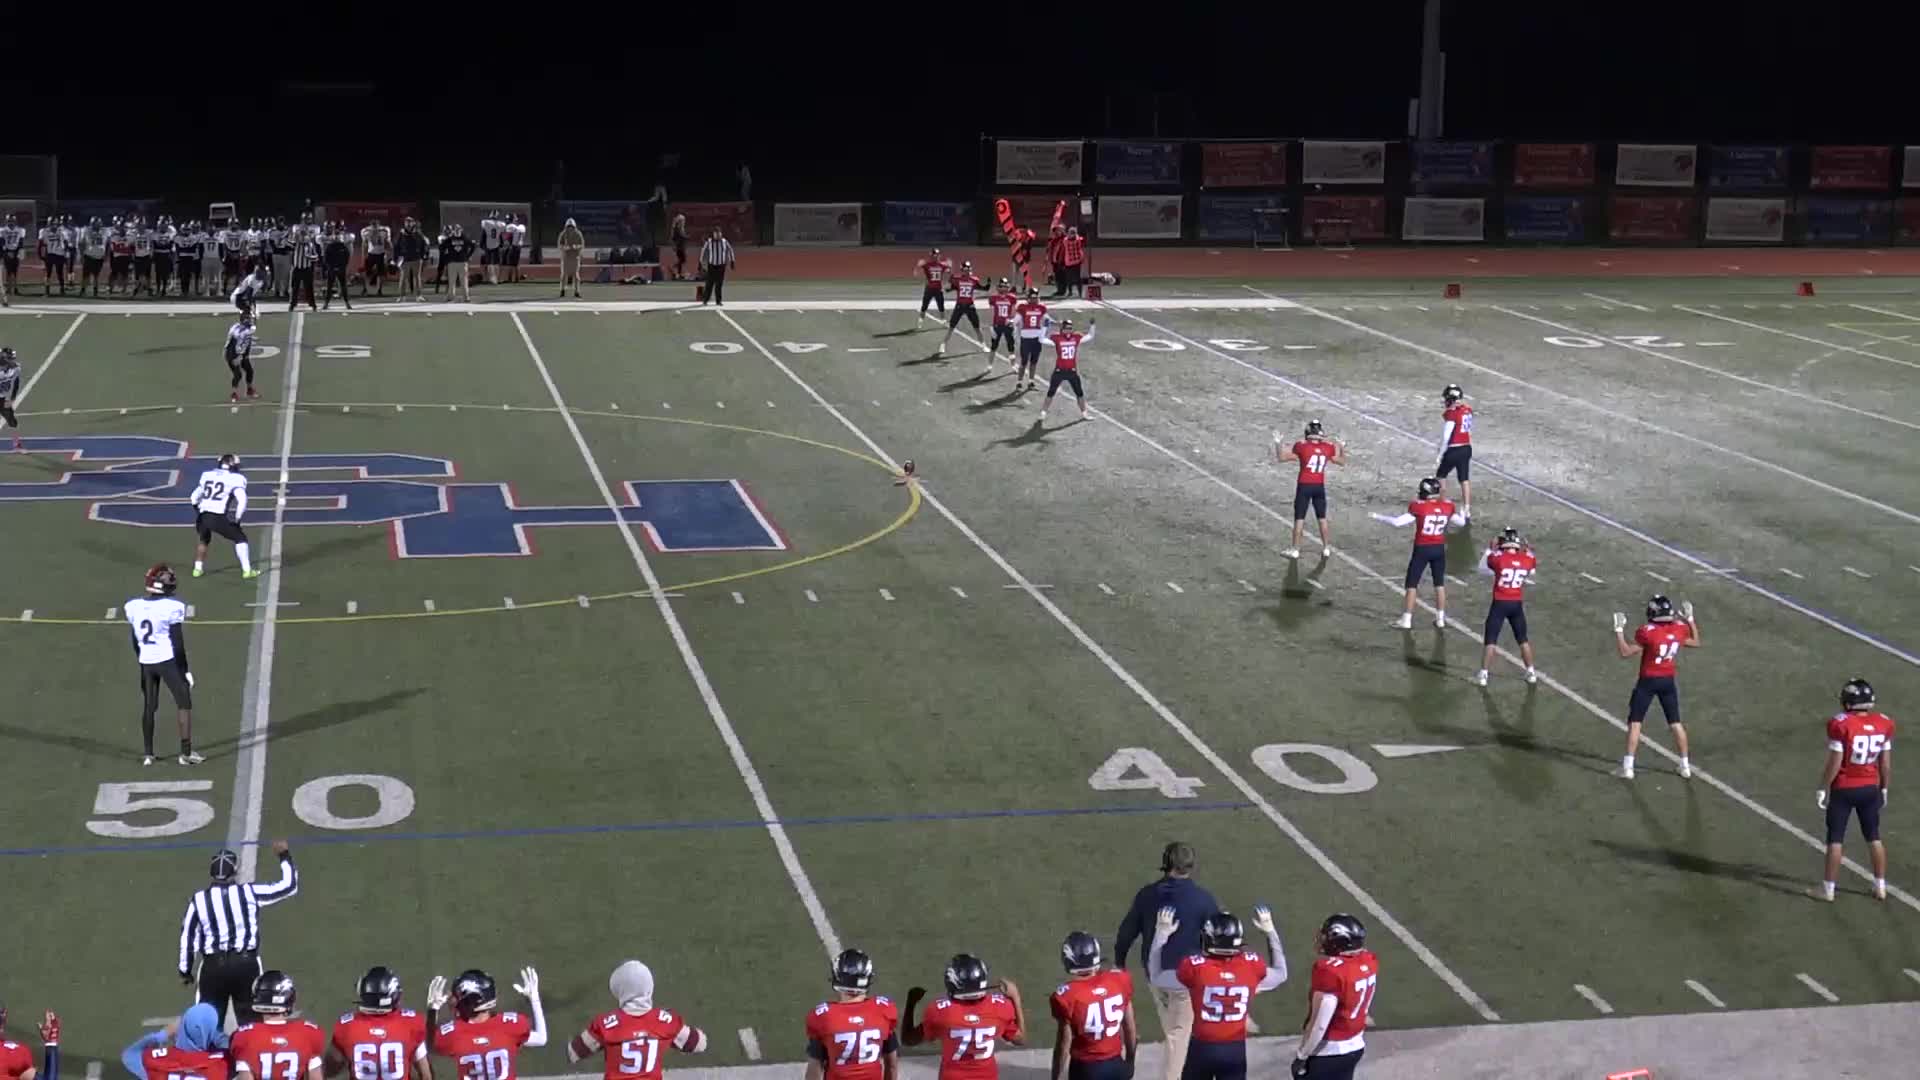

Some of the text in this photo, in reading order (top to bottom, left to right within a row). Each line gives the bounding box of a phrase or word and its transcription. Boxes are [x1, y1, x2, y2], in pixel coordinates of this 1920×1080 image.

[1061, 346, 1075, 360] 20
[1306, 454, 1327, 474] 41
[201, 480, 225, 501] 52
[139, 619, 156, 645] 2
[1083, 994, 1125, 1041] 45
[1201, 985, 1250, 1022] 53
[353, 1042, 404, 1080] 60
[618, 1038, 659, 1075] 51
[833, 1028, 882, 1065] 76
[950, 1026, 997, 1061] 75
